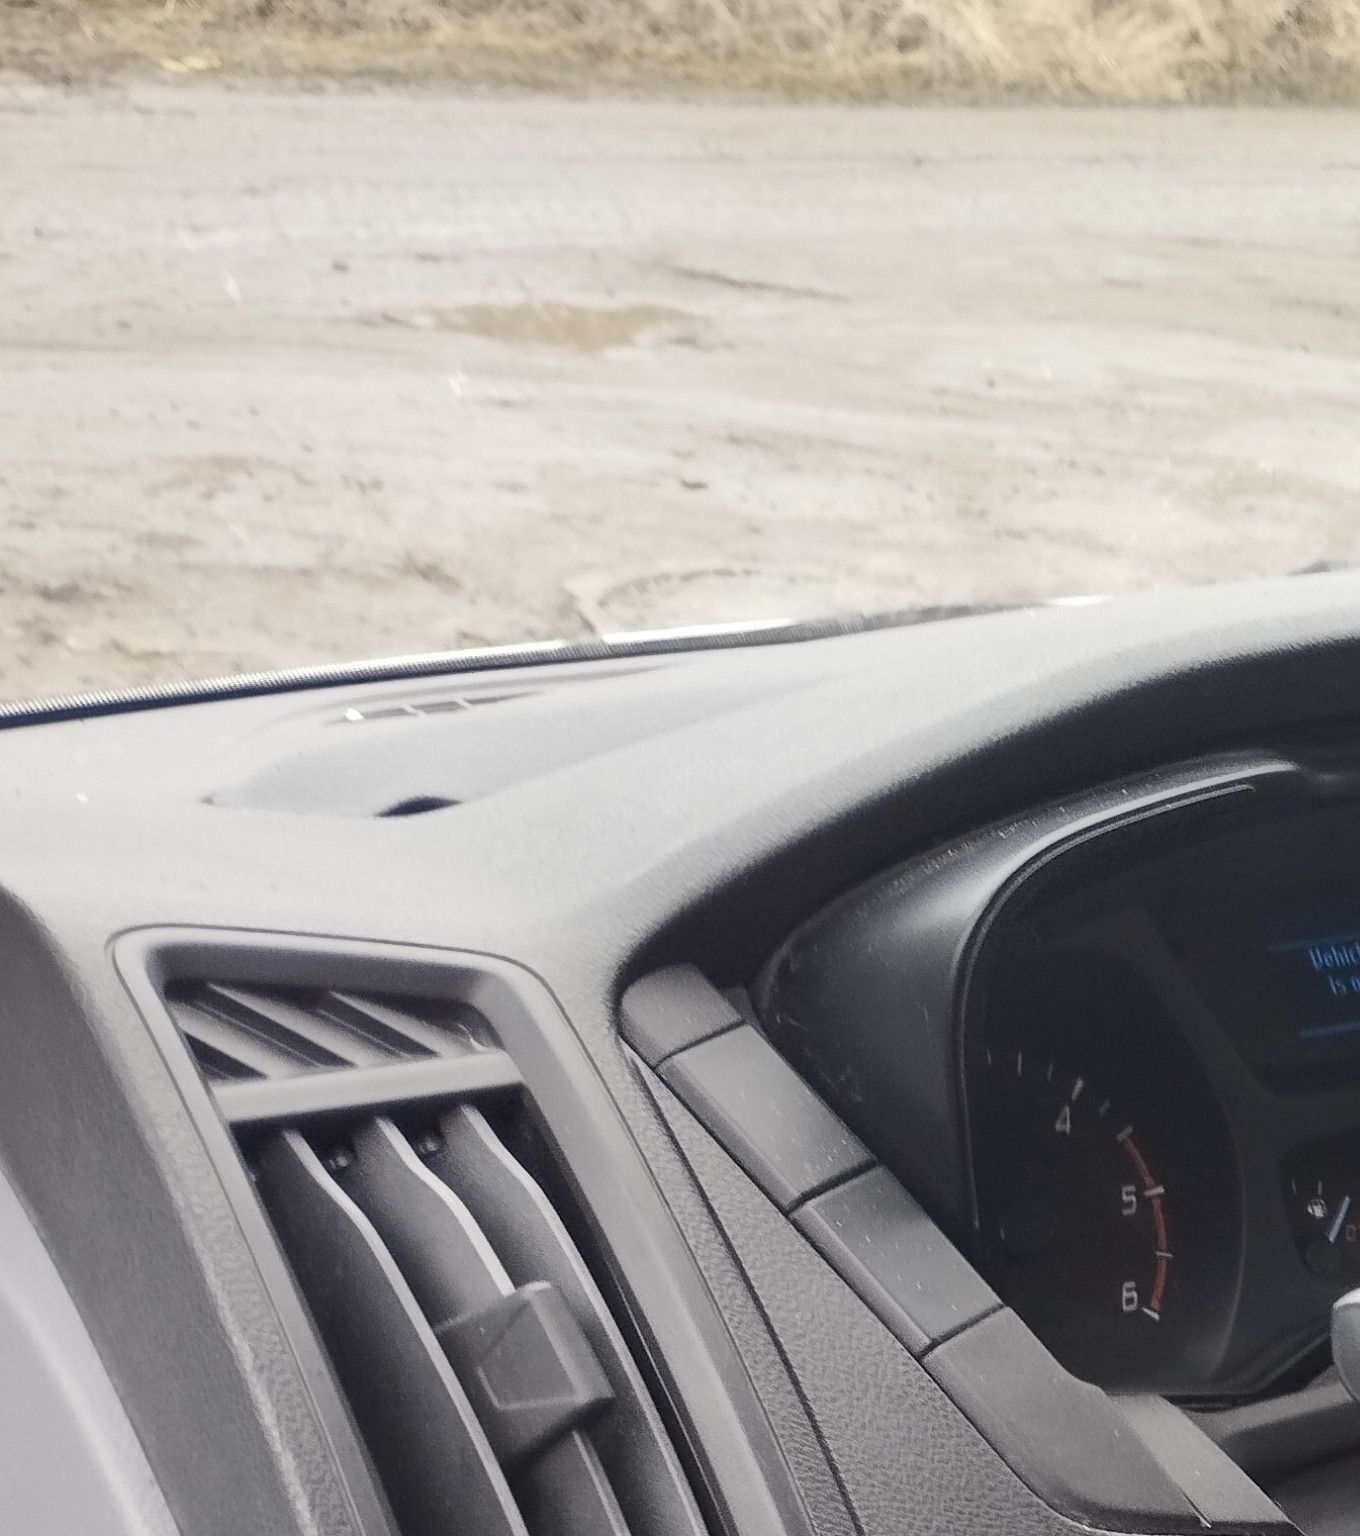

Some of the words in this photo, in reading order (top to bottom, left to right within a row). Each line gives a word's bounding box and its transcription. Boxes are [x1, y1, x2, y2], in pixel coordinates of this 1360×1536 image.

[1055, 1105, 1071, 1136] 4
[1121, 1184, 1137, 1216] 5
[1121, 1281, 1138, 1313] 6
